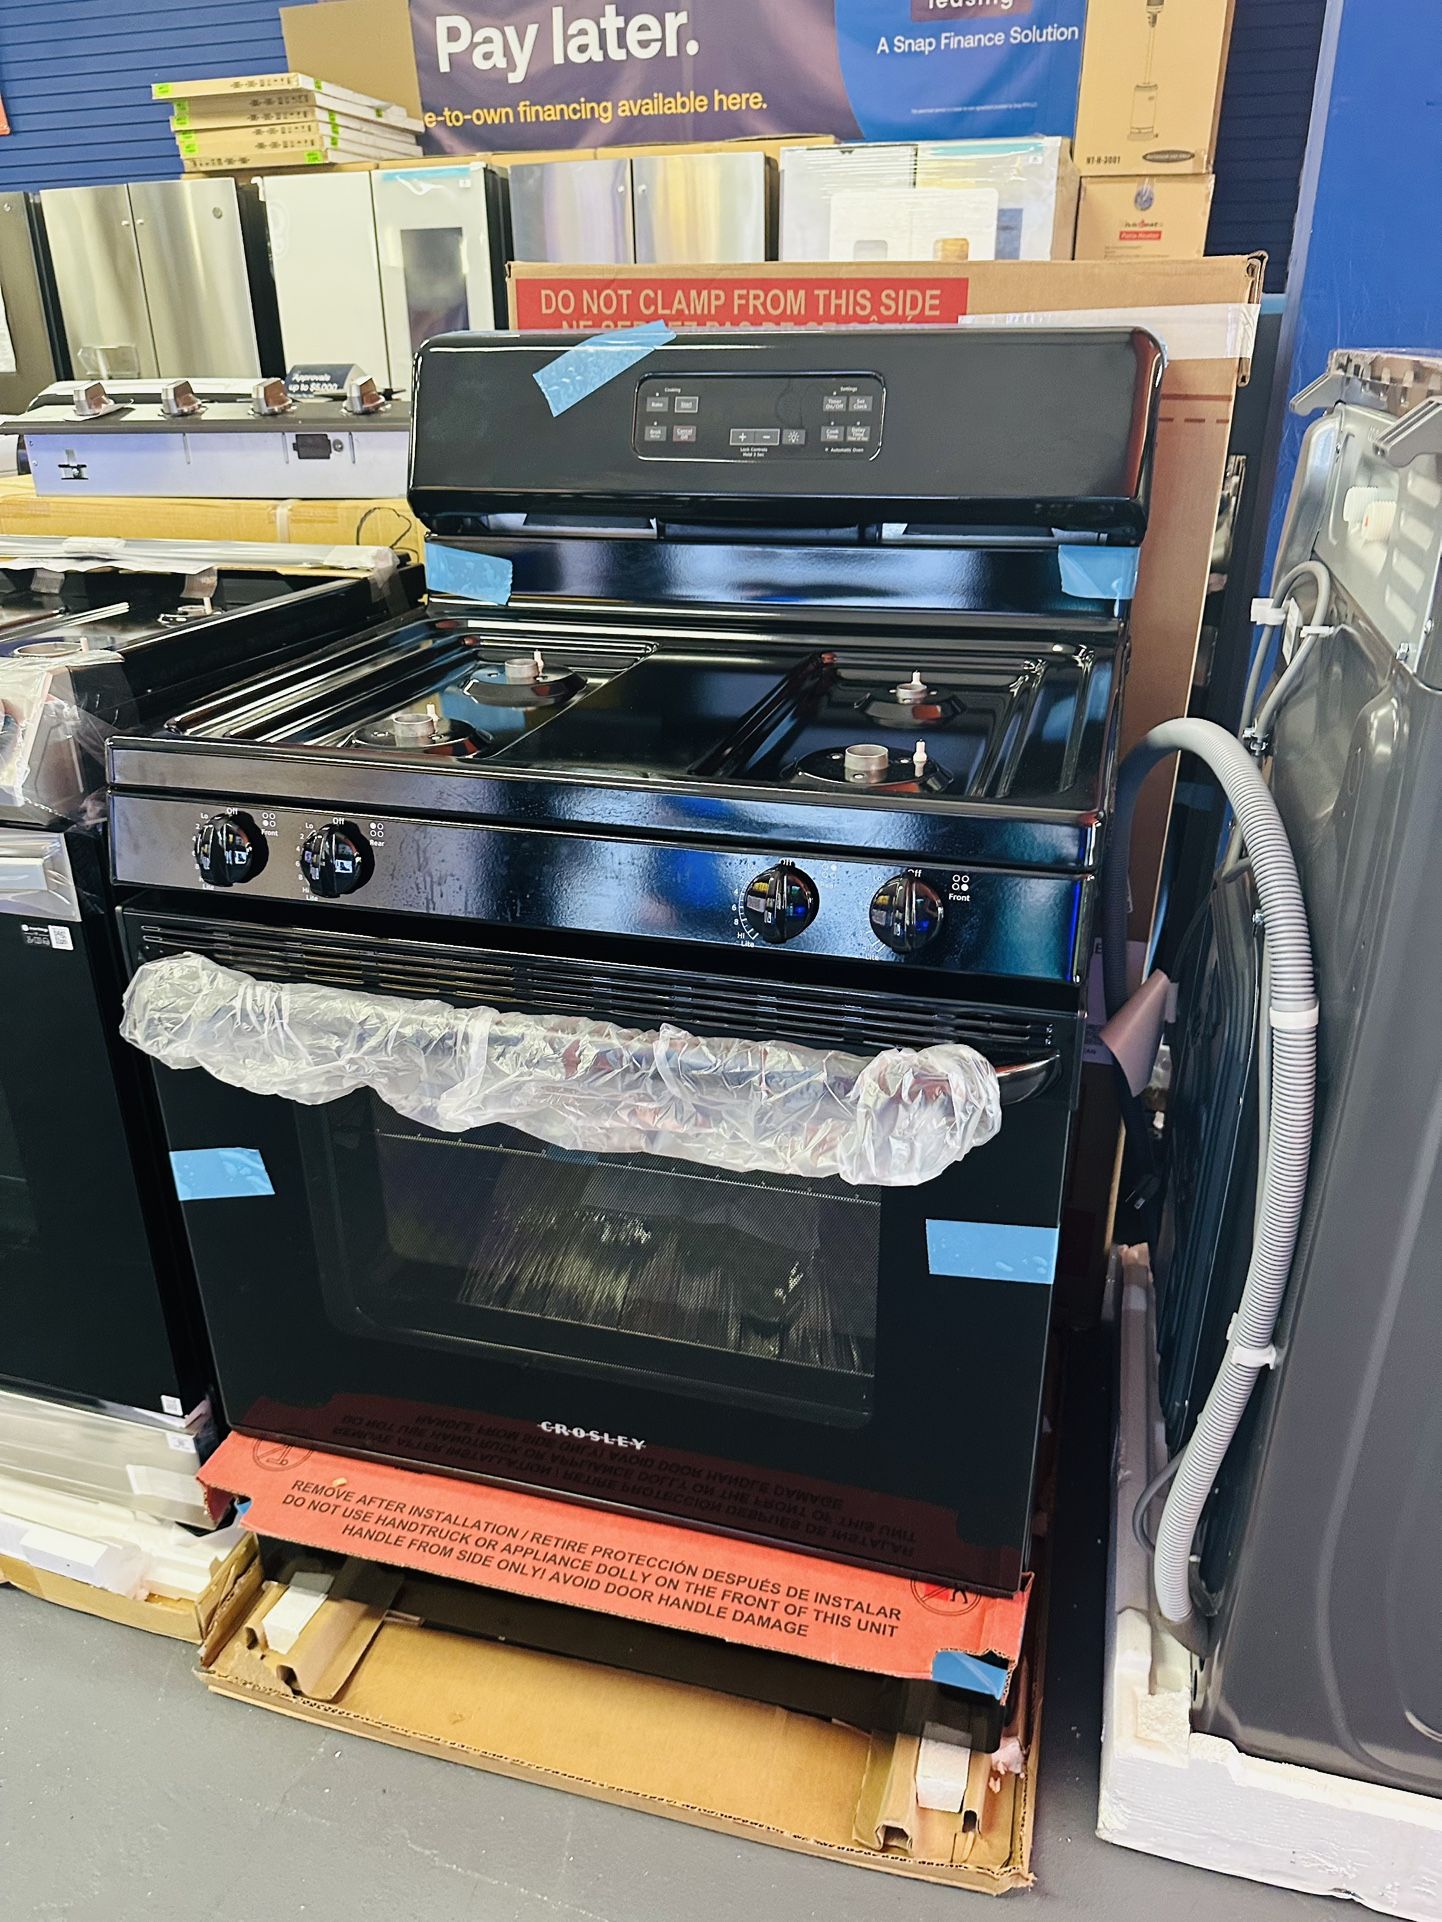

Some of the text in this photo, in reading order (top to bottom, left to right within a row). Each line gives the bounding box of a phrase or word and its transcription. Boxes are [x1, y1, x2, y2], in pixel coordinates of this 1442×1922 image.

[435, 3, 699, 84] Pay later.
[877, 24, 1079, 55] A Snap Finance Solution
[517, 97, 613, 124] financing
[617, 90, 709, 118] available
[712, 89, 768, 111] here.
[540, 289, 941, 316] DO NOT CLAMP FROM THIS SIDE
[288, 384, 299, 392] up
[300, 383, 309, 391] to
[226, 807, 238, 815] Off
[332, 817, 345, 825] Off
[261, 828, 279, 837] Front
[369, 839, 385, 847] Rear
[306, 894, 318, 902] Lite
[948, 893, 971, 902] Front
[740, 940, 755, 948] Lite
[538, 1421, 646, 1450] CROSLEY
[291, 1480, 901, 1621] REMOVE AFTER INSTALLATION / RETIRE PROTECCIÓN DESPUÉS DE INSTALAR
[282, 1494, 899, 1638] DO NOT USE HANDTRUCK OR APPLIANCE DOLLY ON THE FRONT OF THIS UNIT
[342, 1524, 406, 1548] HANDLE
[407, 1538, 455, 1559] FROM
[456, 1549, 495, 1568] SIDE
[548, 1570, 601, 1592] AVOID
[604, 1581, 655, 1603] DOOR
[656, 1593, 729, 1620] HANDLE
[731, 1609, 810, 1637] DAMAGE
